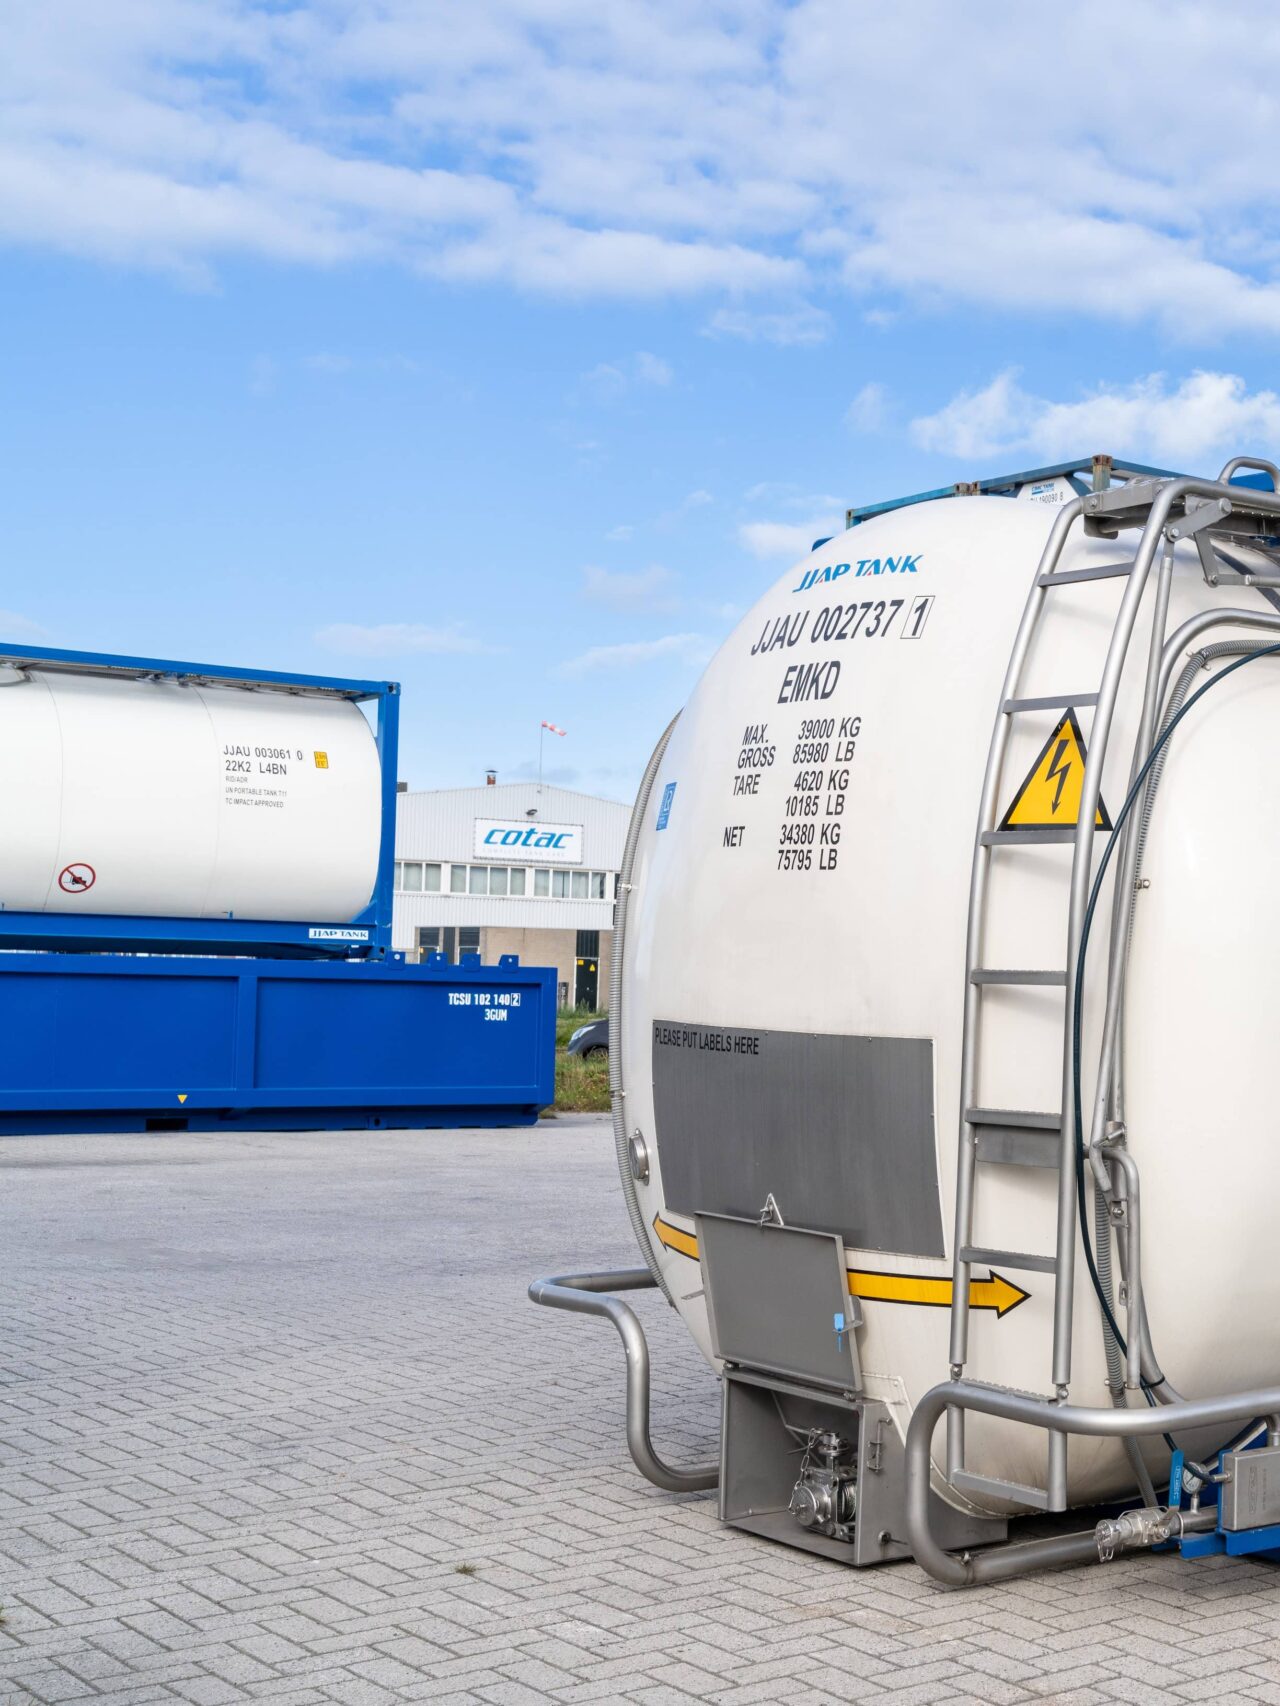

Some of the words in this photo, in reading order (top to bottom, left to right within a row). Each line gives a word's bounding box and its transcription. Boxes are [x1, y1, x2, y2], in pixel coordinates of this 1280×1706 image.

[792, 563, 851, 593] JJAP
[855, 554, 925, 577] TANK
[751, 610, 810, 656] JJAU
[811, 599, 905, 643] 002737
[777, 660, 841, 704] EMKD
[742, 723, 769, 745] MAX.
[798, 718, 835, 740] 39000
[838, 716, 861, 738] KG
[223, 745, 251, 757] JJAU
[255, 747, 291, 759] 003061
[297, 750, 303, 760] 0
[737, 745, 776, 769] GROSS
[792, 742, 829, 764] 85980
[835, 741, 855, 762] LB
[225, 759, 251, 772] 22K2
[259, 763, 287, 775] L4BN
[234, 787, 262, 796] PORTABLE
[733, 774, 761, 796] TARE
[794, 770, 823, 791] 4620
[827, 769, 849, 791] KG
[226, 797, 233, 805] TC
[234, 798, 253, 806] IMPACT
[254, 799, 284, 808] APPROVED
[785, 795, 820, 817] 10185
[825, 794, 845, 816] LB
[484, 827, 574, 849] cotac
[723, 825, 745, 847] NET
[779, 823, 815, 845] 34380
[820, 822, 841, 845] KG
[777, 849, 812, 871] 75795
[819, 848, 838, 870] LB
[341, 930, 367, 939] TANK
[449, 993, 471, 1006] TCSU
[474, 994, 490, 1006] 102
[493, 994, 510, 1006] 140
[484, 1009, 507, 1021] 3GUM
[655, 1027, 681, 1047] PLEASE
[682, 1031, 697, 1049] PUT
[699, 1033, 731, 1052] LABELS
[734, 1035, 759, 1055] HERE
